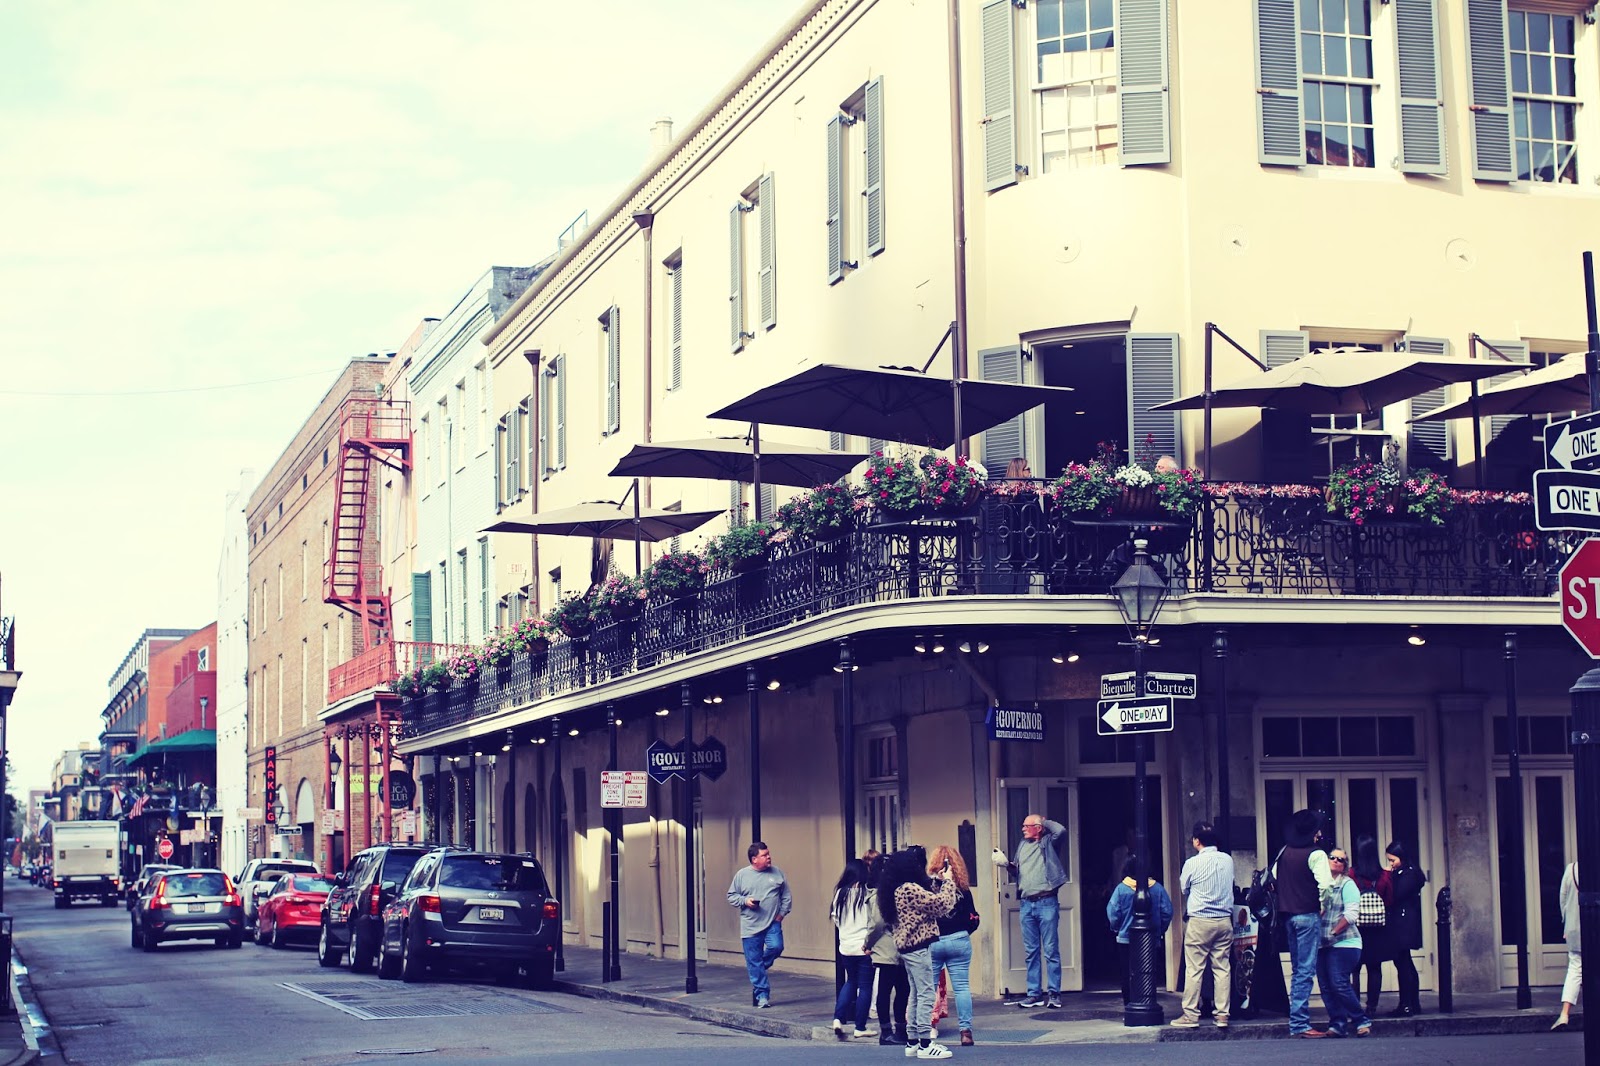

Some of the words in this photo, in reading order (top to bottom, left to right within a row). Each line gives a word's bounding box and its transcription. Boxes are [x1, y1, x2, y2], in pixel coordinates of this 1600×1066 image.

[1573, 432, 1597, 457] ONE
[1557, 489, 1591, 512] ONE
[1103, 681, 1136, 695] Bienville
[1147, 680, 1193, 694] Chartres
[999, 710, 1042, 730] GOVERNOR
[1120, 709, 1139, 722] ONE
[160, 845, 173, 853] STOP
